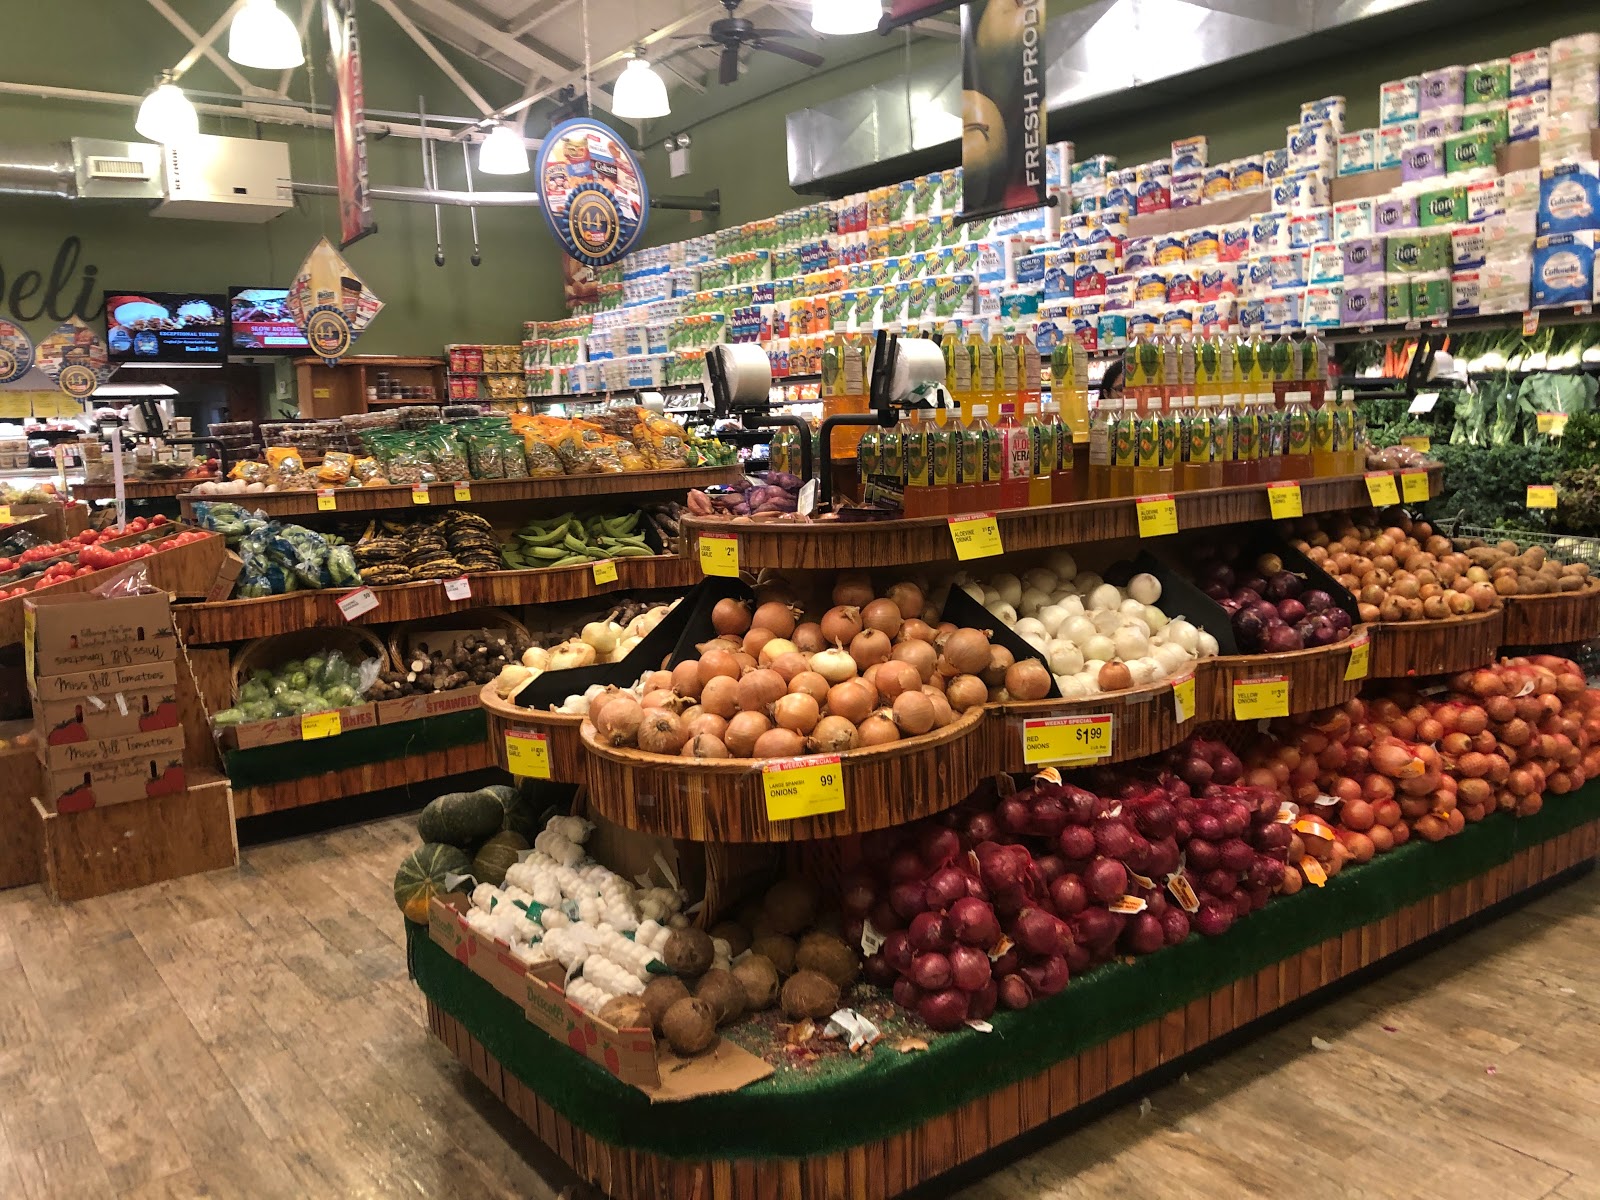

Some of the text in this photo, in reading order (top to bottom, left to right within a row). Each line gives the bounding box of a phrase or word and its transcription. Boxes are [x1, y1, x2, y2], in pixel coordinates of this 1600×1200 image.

[1022, 0, 1040, 187] FRESH PROD
[0, 235, 105, 322] eli
[1013, 440, 1029, 450] ALOE
[1012, 451, 1029, 462] VERA
[54, 670, 164, 692] Miss Jill Tomatoes
[1069, 717, 1093, 725] SPECIAL
[1026, 735, 1039, 743] RED
[65, 736, 174, 761] Miss Jill Tomatoes
[1026, 742, 1050, 751] ONIONS
[783, 758, 833, 770] WEEKLY SPECIAL
[785, 780, 805, 788] SPANISH
[770, 787, 798, 798] ONIONS
